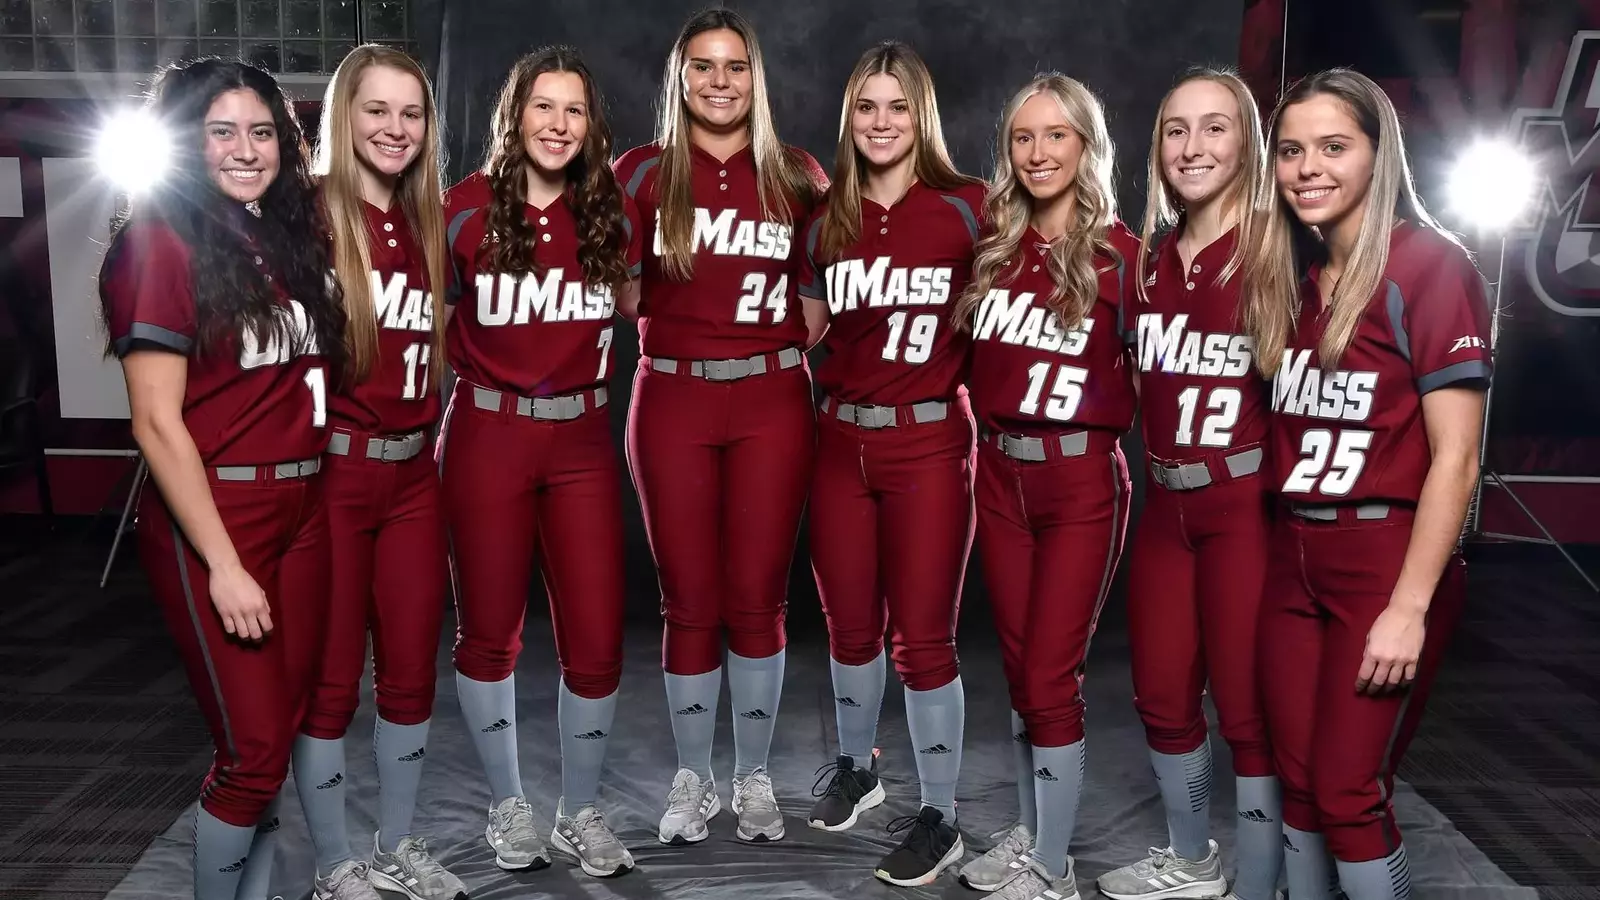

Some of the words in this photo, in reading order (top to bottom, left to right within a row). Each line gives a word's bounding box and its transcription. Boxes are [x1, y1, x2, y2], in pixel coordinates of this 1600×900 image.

[653, 207, 792, 261] MASS
[371, 269, 433, 331] MAS
[475, 267, 616, 326] UMASS
[734, 272, 789, 325] 24
[825, 256, 953, 316] UMASS
[594, 325, 614, 381] 7
[881, 311, 939, 364] 19
[1019, 360, 1089, 422] 15
[1271, 348, 1380, 422] MASS
[1174, 385, 1242, 448] 12
[1281, 428, 1374, 497] 25
